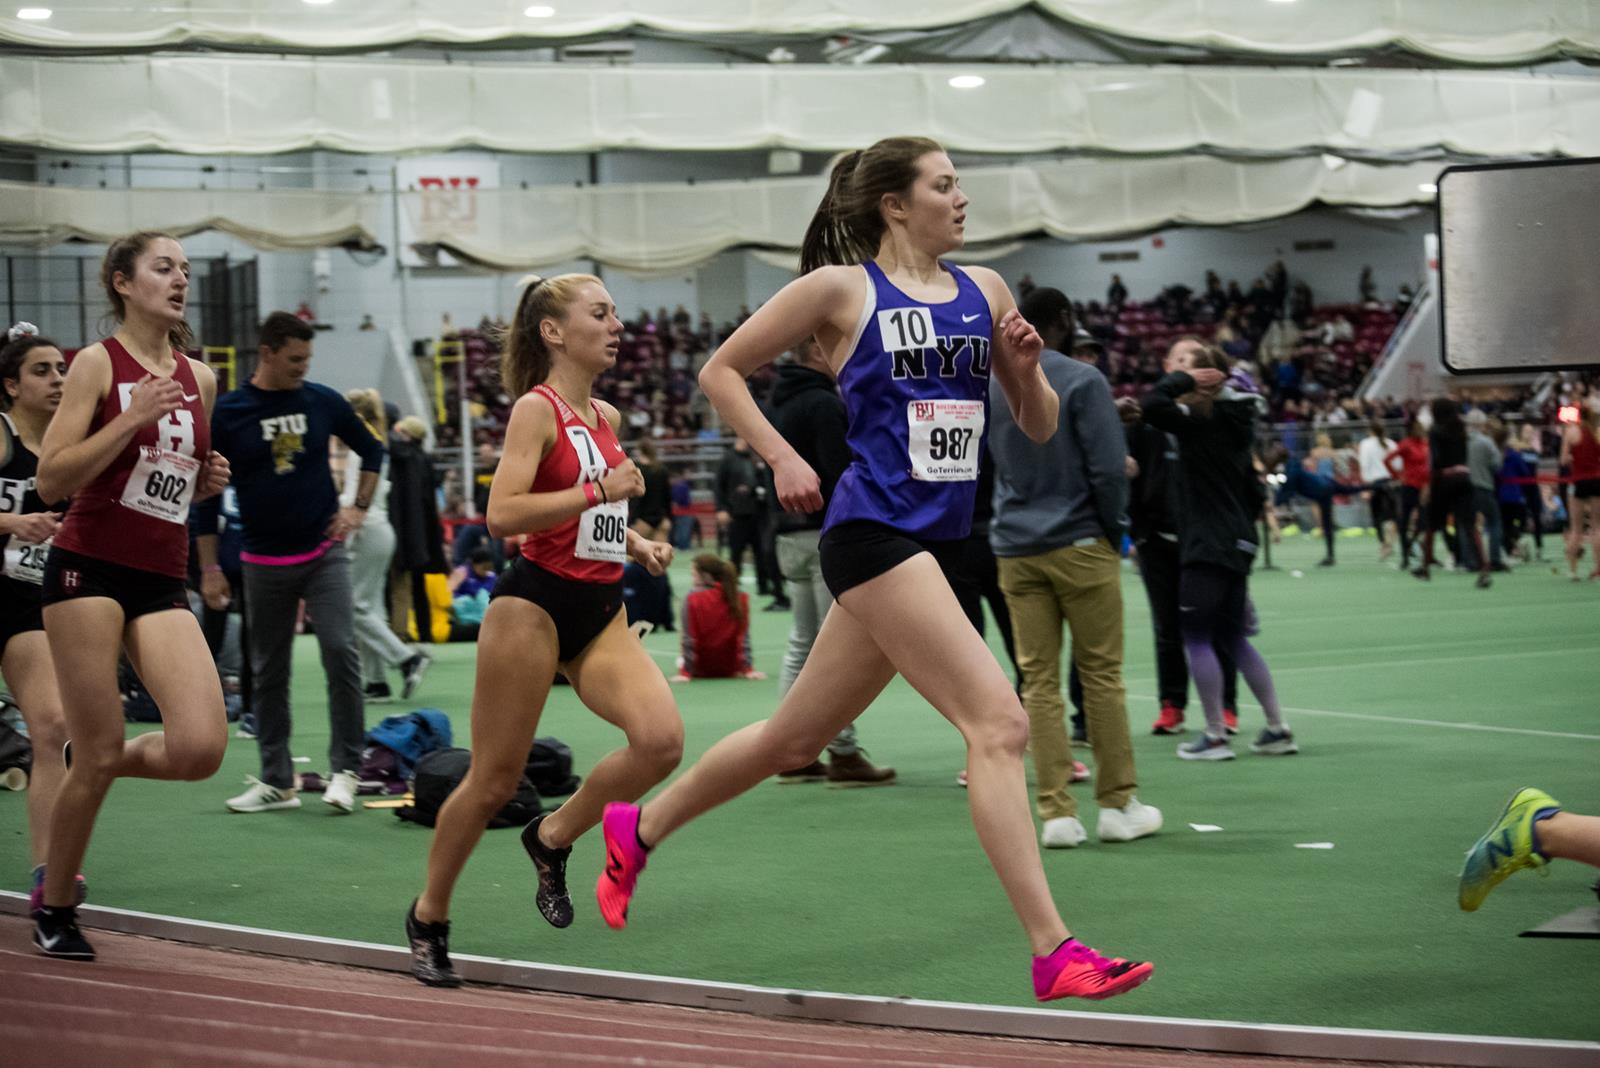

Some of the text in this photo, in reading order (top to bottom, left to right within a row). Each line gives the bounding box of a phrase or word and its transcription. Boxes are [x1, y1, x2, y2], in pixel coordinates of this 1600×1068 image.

[890, 310, 927, 347] 10
[891, 335, 990, 380] NYU
[260, 413, 308, 440] FIU
[915, 402, 935, 418] BU
[573, 430, 596, 466] 7
[930, 427, 973, 461] 987
[145, 471, 187, 505] 602
[593, 514, 625, 544] 806
[65, 571, 78, 587] H
